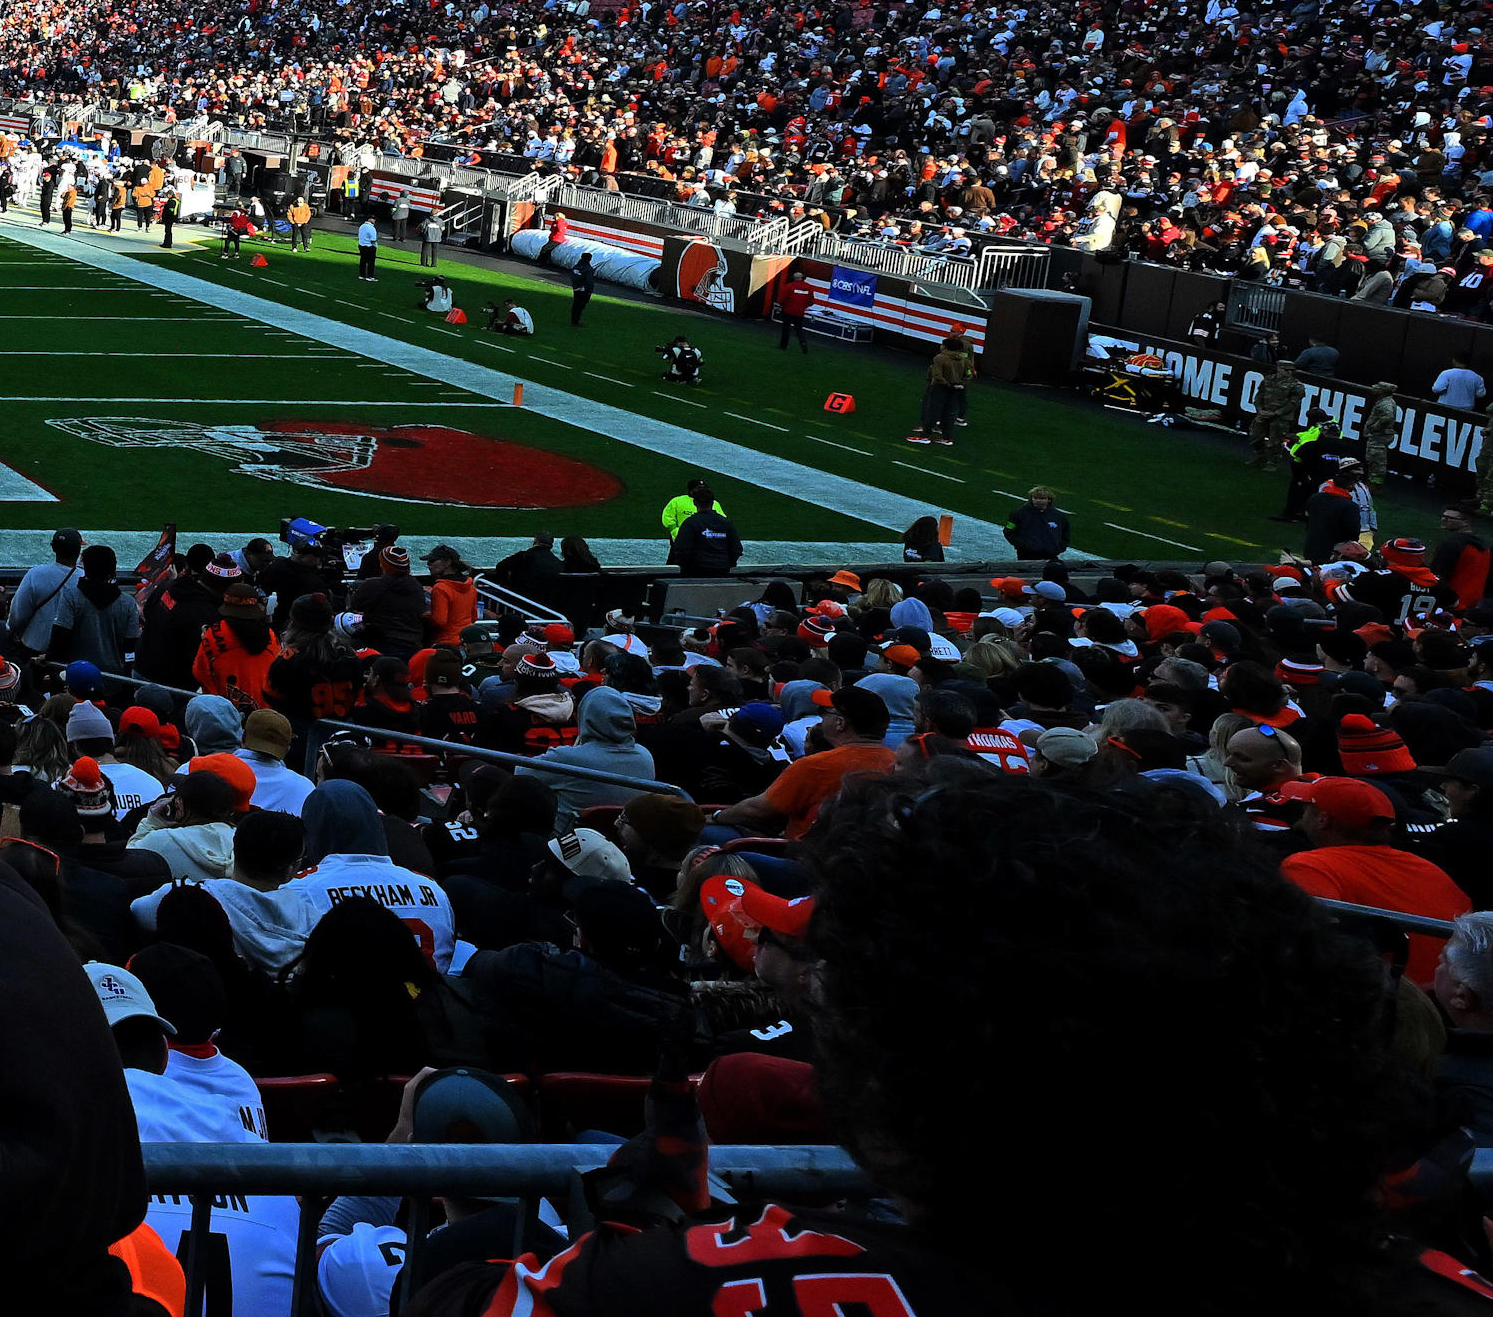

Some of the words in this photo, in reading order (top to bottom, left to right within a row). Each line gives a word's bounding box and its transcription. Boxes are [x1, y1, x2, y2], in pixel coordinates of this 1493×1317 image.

[829, 395, 847, 410] G
[1298, 383, 1367, 441] THE
[419, 885, 439, 907] JR
